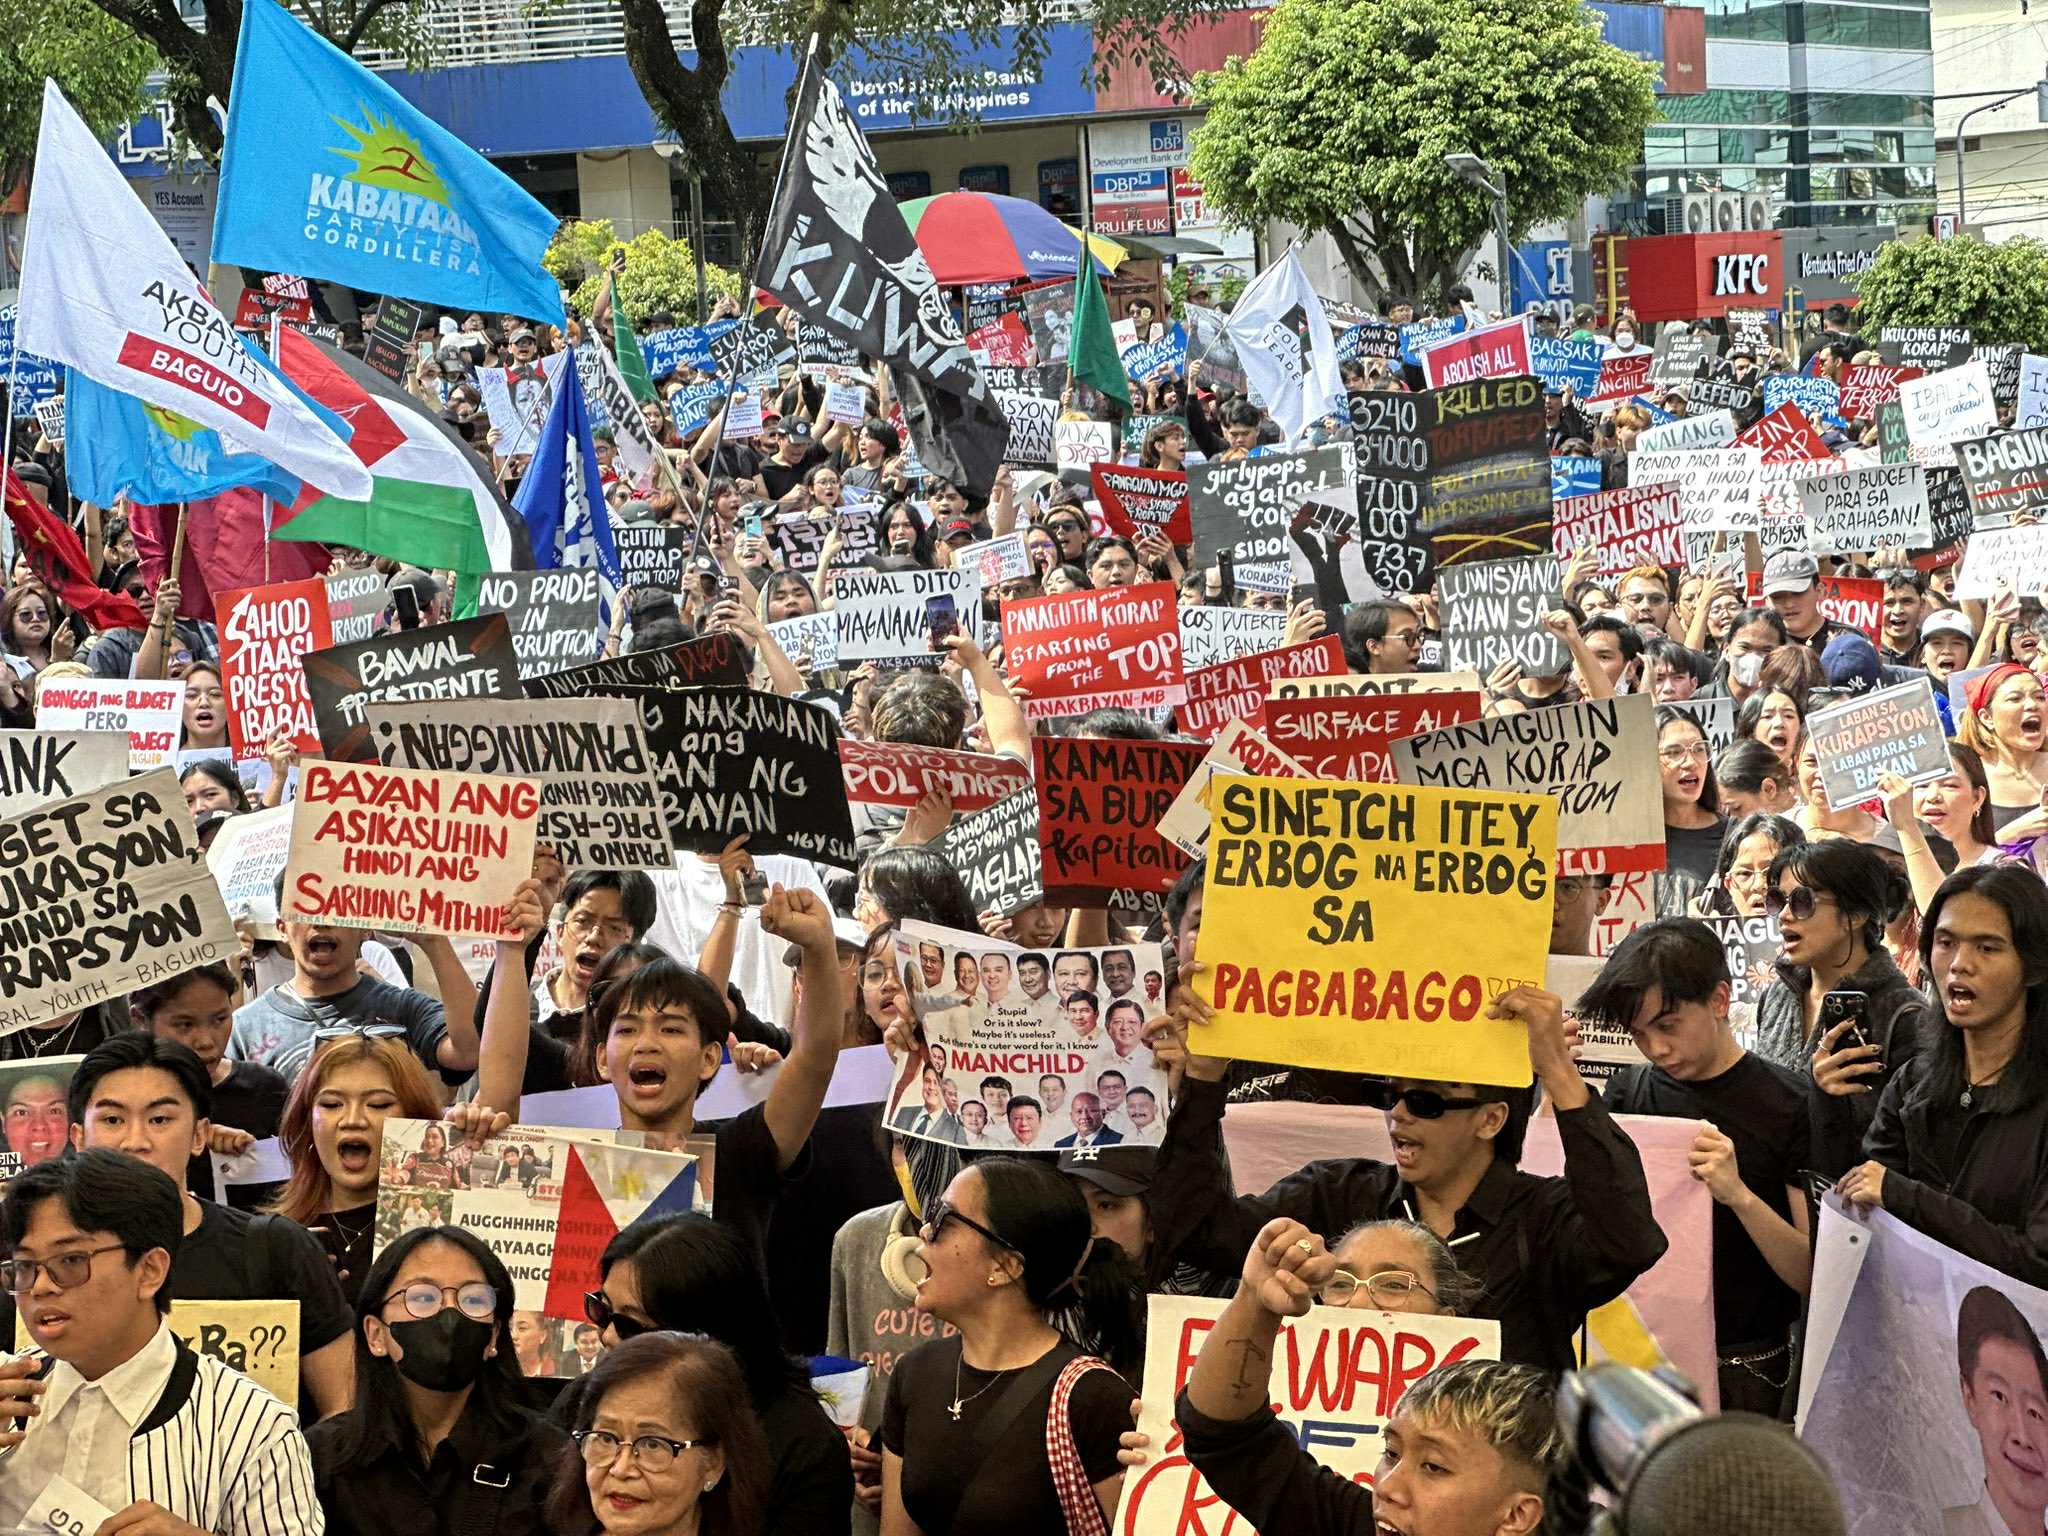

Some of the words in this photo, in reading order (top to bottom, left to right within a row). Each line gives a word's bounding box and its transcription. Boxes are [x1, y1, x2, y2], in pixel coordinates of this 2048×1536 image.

[858, 100, 876, 116] of
[882, 99, 914, 114] the
[1152, 137, 1181, 150] DBP
[1094, 155, 1148, 168] Development
[1152, 154, 1170, 163] Bank
[155, 192, 170, 205] YES
[172, 192, 204, 205] Account
[1105, 178, 1138, 192] DBP
[307, 208, 481, 258] PARTYLIST
[1095, 221, 1119, 232] PRU
[1121, 219, 1143, 231] LIFE
[1146, 218, 1166, 229] UK
[304, 224, 480, 276] CORDILLERA
[1802, 251, 1836, 278] Kentucky
[1837, 250, 1855, 273] Fried
[1716, 254, 1768, 295] KFC
[654, 338, 703, 351] mismo
[800, 325, 825, 340] SAYO
[1734, 333, 1769, 345] SALE
[1742, 326, 1763, 335] FOR
[1882, 327, 1936, 342] IKULONG
[1940, 328, 1970, 343] MGA
[162, 308, 259, 384] YOUTH
[1902, 342, 1951, 357] KORAP!
[150, 350, 244, 406] BAGUIO
[1442, 354, 1491, 386] ABOLISH
[1494, 345, 1516, 371] ALL
[1847, 366, 1904, 388] JUNK
[1436, 381, 1537, 423] KILLED
[1691, 381, 1751, 409] DEFEND
[1912, 373, 1979, 410] IBALIK
[1352, 397, 1418, 434] 3240
[1354, 435, 1428, 470] 34000
[1641, 422, 1724, 453] WALANG
[1203, 459, 1307, 494] girlypops
[1635, 455, 1681, 472] PONDO
[1727, 452, 1746, 466] SA
[1100, 472, 1158, 494] PANAGUTIN
[1159, 480, 1188, 497] MGA
[1357, 474, 1418, 514] 700
[1806, 478, 1828, 495] NO
[1835, 475, 1851, 490] TO
[1859, 466, 1919, 488] BUDGET
[1724, 490, 1749, 503] NA
[1825, 493, 1861, 513] PARA
[1868, 489, 1889, 507] SA
[1975, 483, 2006, 510] FOR
[1814, 503, 1921, 534] KARAHASAN!
[620, 548, 681, 569] KORAP
[1364, 541, 1427, 575] 737
[1600, 527, 1687, 572] BAGSAK!
[479, 578, 517, 608] NO
[531, 570, 597, 601] PRIDE
[627, 570, 651, 585] FROM
[653, 569, 679, 585] TOP!
[835, 574, 905, 600] BAWAL
[914, 570, 971, 594] DITO:
[1440, 559, 1559, 603] LUWISYANO
[225, 592, 311, 663] SAHOD
[522, 607, 549, 631] IN
[1007, 596, 1098, 635] PANAGUTIN
[1102, 599, 1164, 628] KORAP
[1223, 611, 1287, 631] DUTERTE
[1449, 595, 1510, 634] AYAW
[1516, 594, 1549, 628] SA
[358, 635, 476, 688] BAWAL
[1011, 633, 1111, 667] STARTING
[1109, 632, 1178, 679] TOP
[1047, 658, 1091, 679] FROM
[1263, 656, 1287, 681] BP
[1288, 649, 1330, 677] 880
[1070, 667, 1103, 688] THE
[42, 690, 97, 710] BONGGA
[100, 694, 123, 706] ANG
[125, 691, 176, 710] BUDGET
[1028, 688, 1166, 718] ANAKBAYAN-MB
[1184, 692, 1263, 730] UPHOLD
[85, 712, 128, 730] PERO
[686, 694, 828, 750] NAKAWAN
[1275, 711, 1400, 741] SURFACE
[1410, 698, 1619, 758] PANAGUTIN
[1839, 709, 1879, 729] LABAN
[1880, 703, 1898, 718] SA
[681, 730, 744, 756] ang
[1817, 706, 1936, 759] KURAPSYON,
[844, 747, 897, 766] SAY
[1416, 758, 1490, 787] MGA
[1507, 742, 1612, 785] KORAP
[1832, 753, 1874, 774] LABAN
[1873, 742, 1908, 760] PARA
[1908, 734, 1927, 749] SA
[750, 756, 807, 797] NG
[842, 763, 919, 795] POL
[1854, 754, 1917, 790] BAYAN
[304, 767, 440, 812] BAYAN
[450, 778, 539, 820] ANG
[598, 779, 655, 806] KUNG
[1047, 784, 1091, 823] SA
[103, 792, 162, 828] SA
[661, 791, 776, 834] BAYAN
[1221, 784, 1416, 842] SINETCH
[1439, 798, 1543, 860] ITEY,
[314, 810, 507, 860] ASIKASUHIN
[344, 847, 410, 878] HINDI
[416, 856, 479, 882] ANG
[589, 840, 671, 867] PAANO
[1214, 840, 1358, 891] ERBOG
[1374, 854, 1407, 882] NA
[1414, 850, 1548, 900] ERBOG
[93, 882, 139, 919] SA
[1107, 889, 1140, 908] AB
[1307, 896, 1374, 945] SA
[41, 982, 109, 1015] YOUTH
[136, 943, 216, 984] BAGUIO
[984, 1019, 995, 1027] Or
[998, 1019, 1005, 1027] is
[1007, 1019, 1014, 1027] it
[1016, 1019, 1042, 1027] slow?
[998, 1008, 1027, 1018] Stupid
[939, 1035, 950, 1044] But
[952, 1039, 979, 1049] there's
[1056, 1042, 1065, 1050] it,
[972, 1030, 1002, 1040] Maybe
[1019, 1030, 1056, 1038] useless?
[951, 1050, 1085, 1073] MANCHILD
[874, 1308, 936, 1337] CUTE
